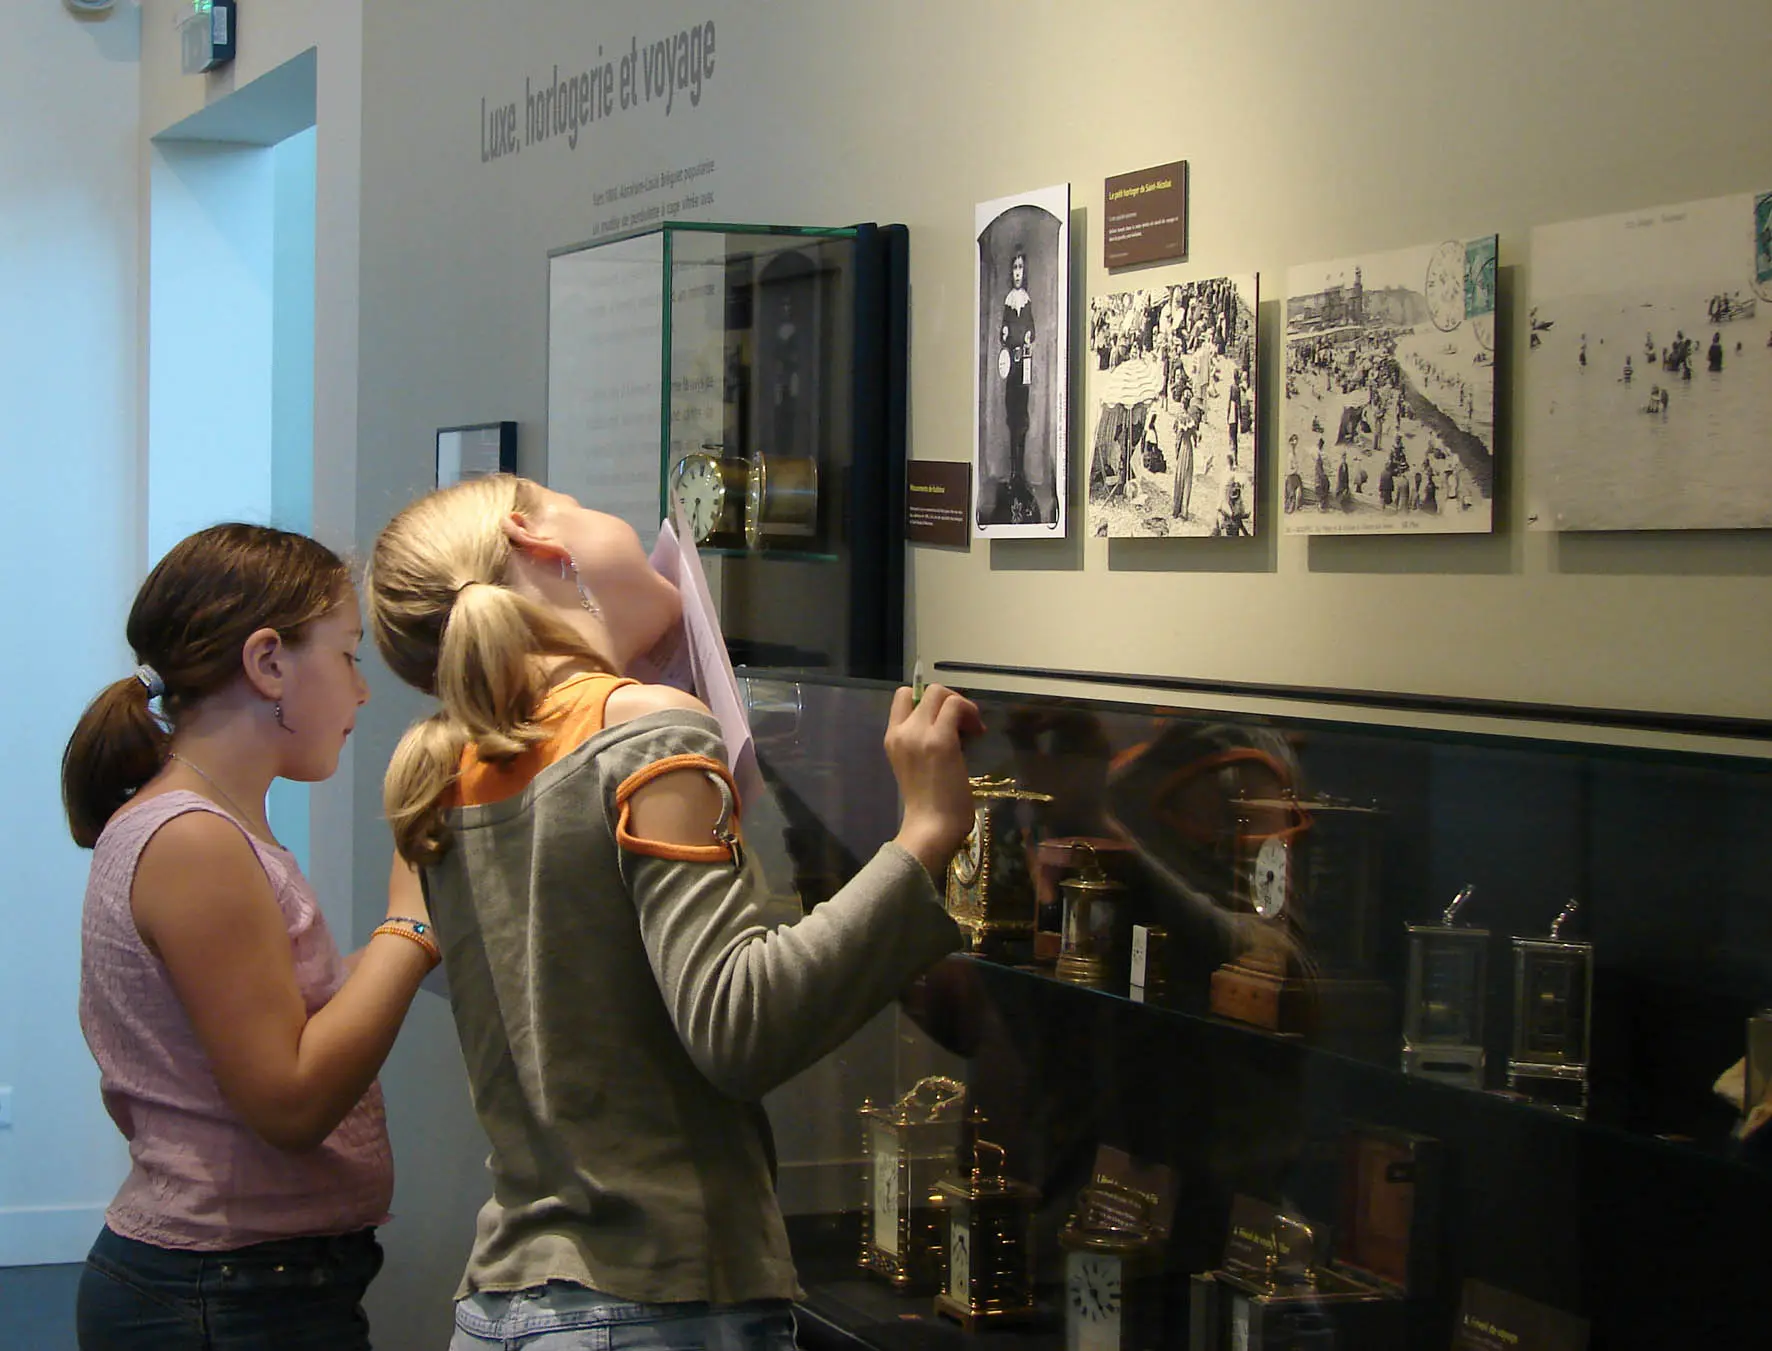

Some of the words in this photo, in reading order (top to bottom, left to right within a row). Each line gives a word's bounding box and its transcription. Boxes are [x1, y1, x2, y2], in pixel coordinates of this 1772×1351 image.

[481, 96, 520, 163] Luxe,
[526, 44, 614, 151] horlogerie
[620, 36, 638, 111] et
[643, 19, 716, 117] voyage
